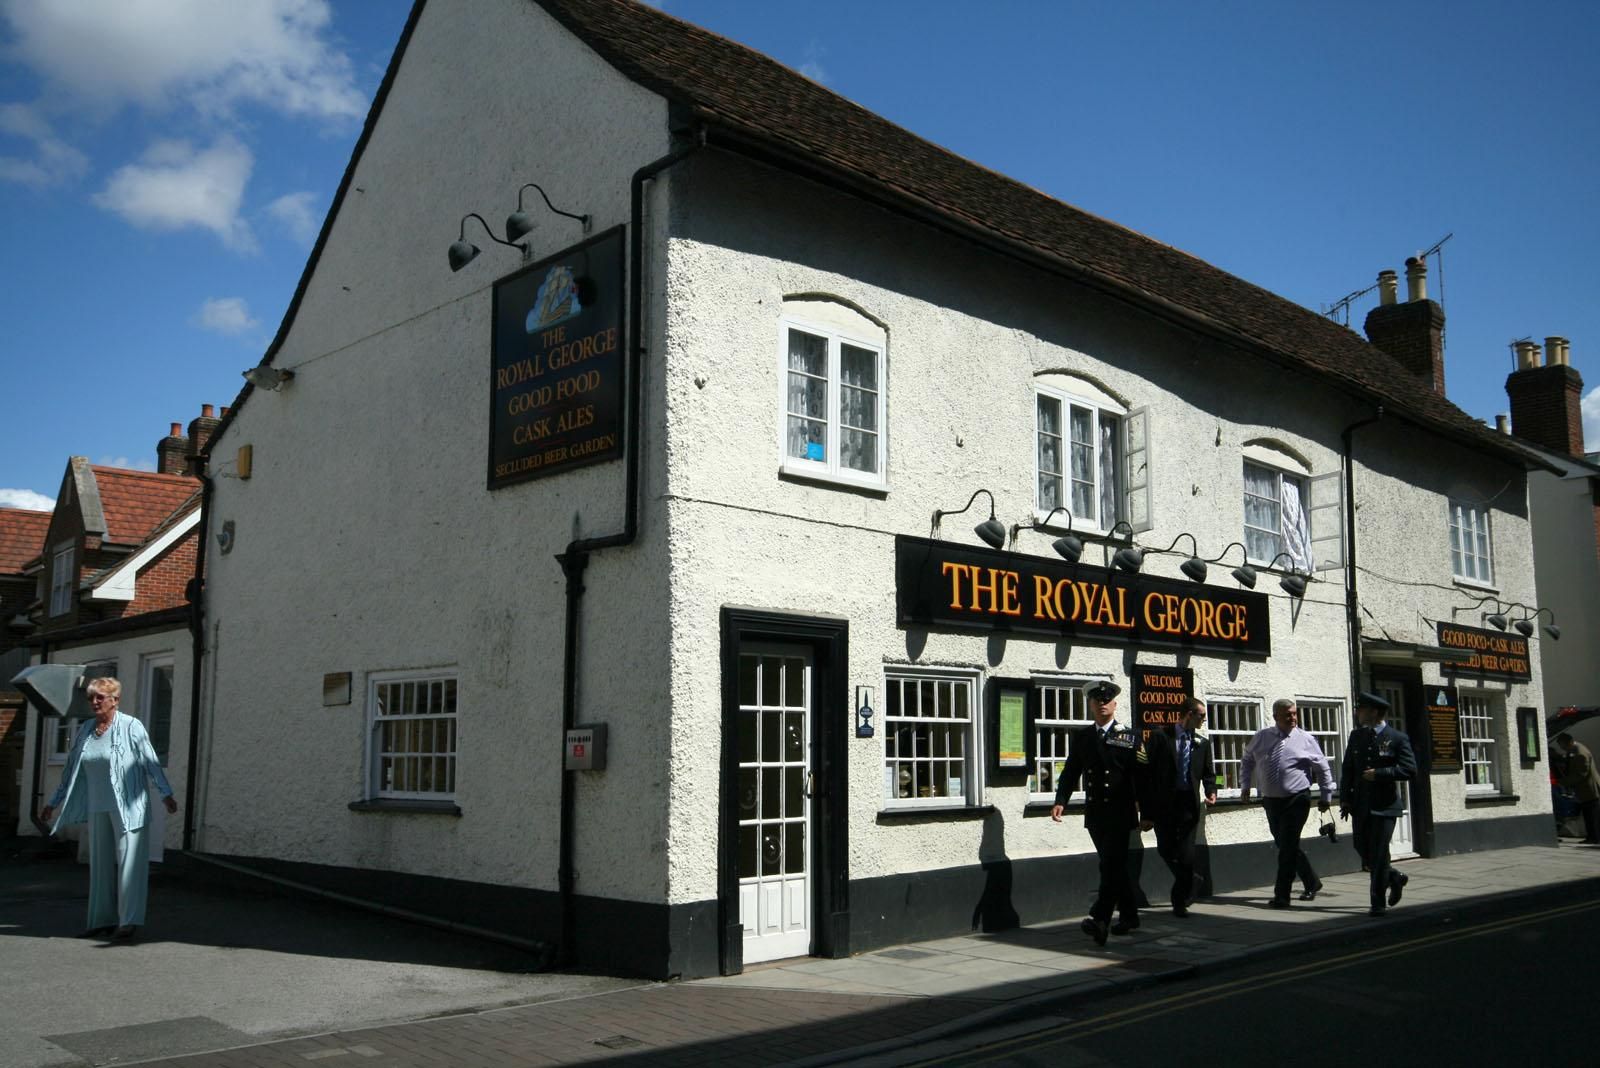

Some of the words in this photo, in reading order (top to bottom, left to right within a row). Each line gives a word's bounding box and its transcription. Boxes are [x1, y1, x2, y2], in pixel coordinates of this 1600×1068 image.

[542, 326, 567, 348] THE
[496, 354, 544, 390] ROYAL
[547, 327, 617, 371] GEORGE
[508, 385, 552, 416] GOOD
[557, 369, 601, 401] FOOD
[513, 417, 551, 446] CASK
[556, 404, 595, 433] ALES
[495, 454, 542, 478] SECLUDED
[544, 448, 567, 465] BEER
[570, 433, 616, 458] GARDEN
[942, 561, 1021, 616] THE
[1033, 574, 1136, 629] ROYAL
[1143, 591, 1249, 642] GEORGE
[1442, 629, 1466, 646] GOOD
[1500, 657, 1528, 673] GARDEN
[1143, 674, 1184, 689] WELCOME
[1139, 691, 1165, 704] GOOD
[1143, 710, 1165, 723] CASK
[1166, 711, 1182, 724] ALE
